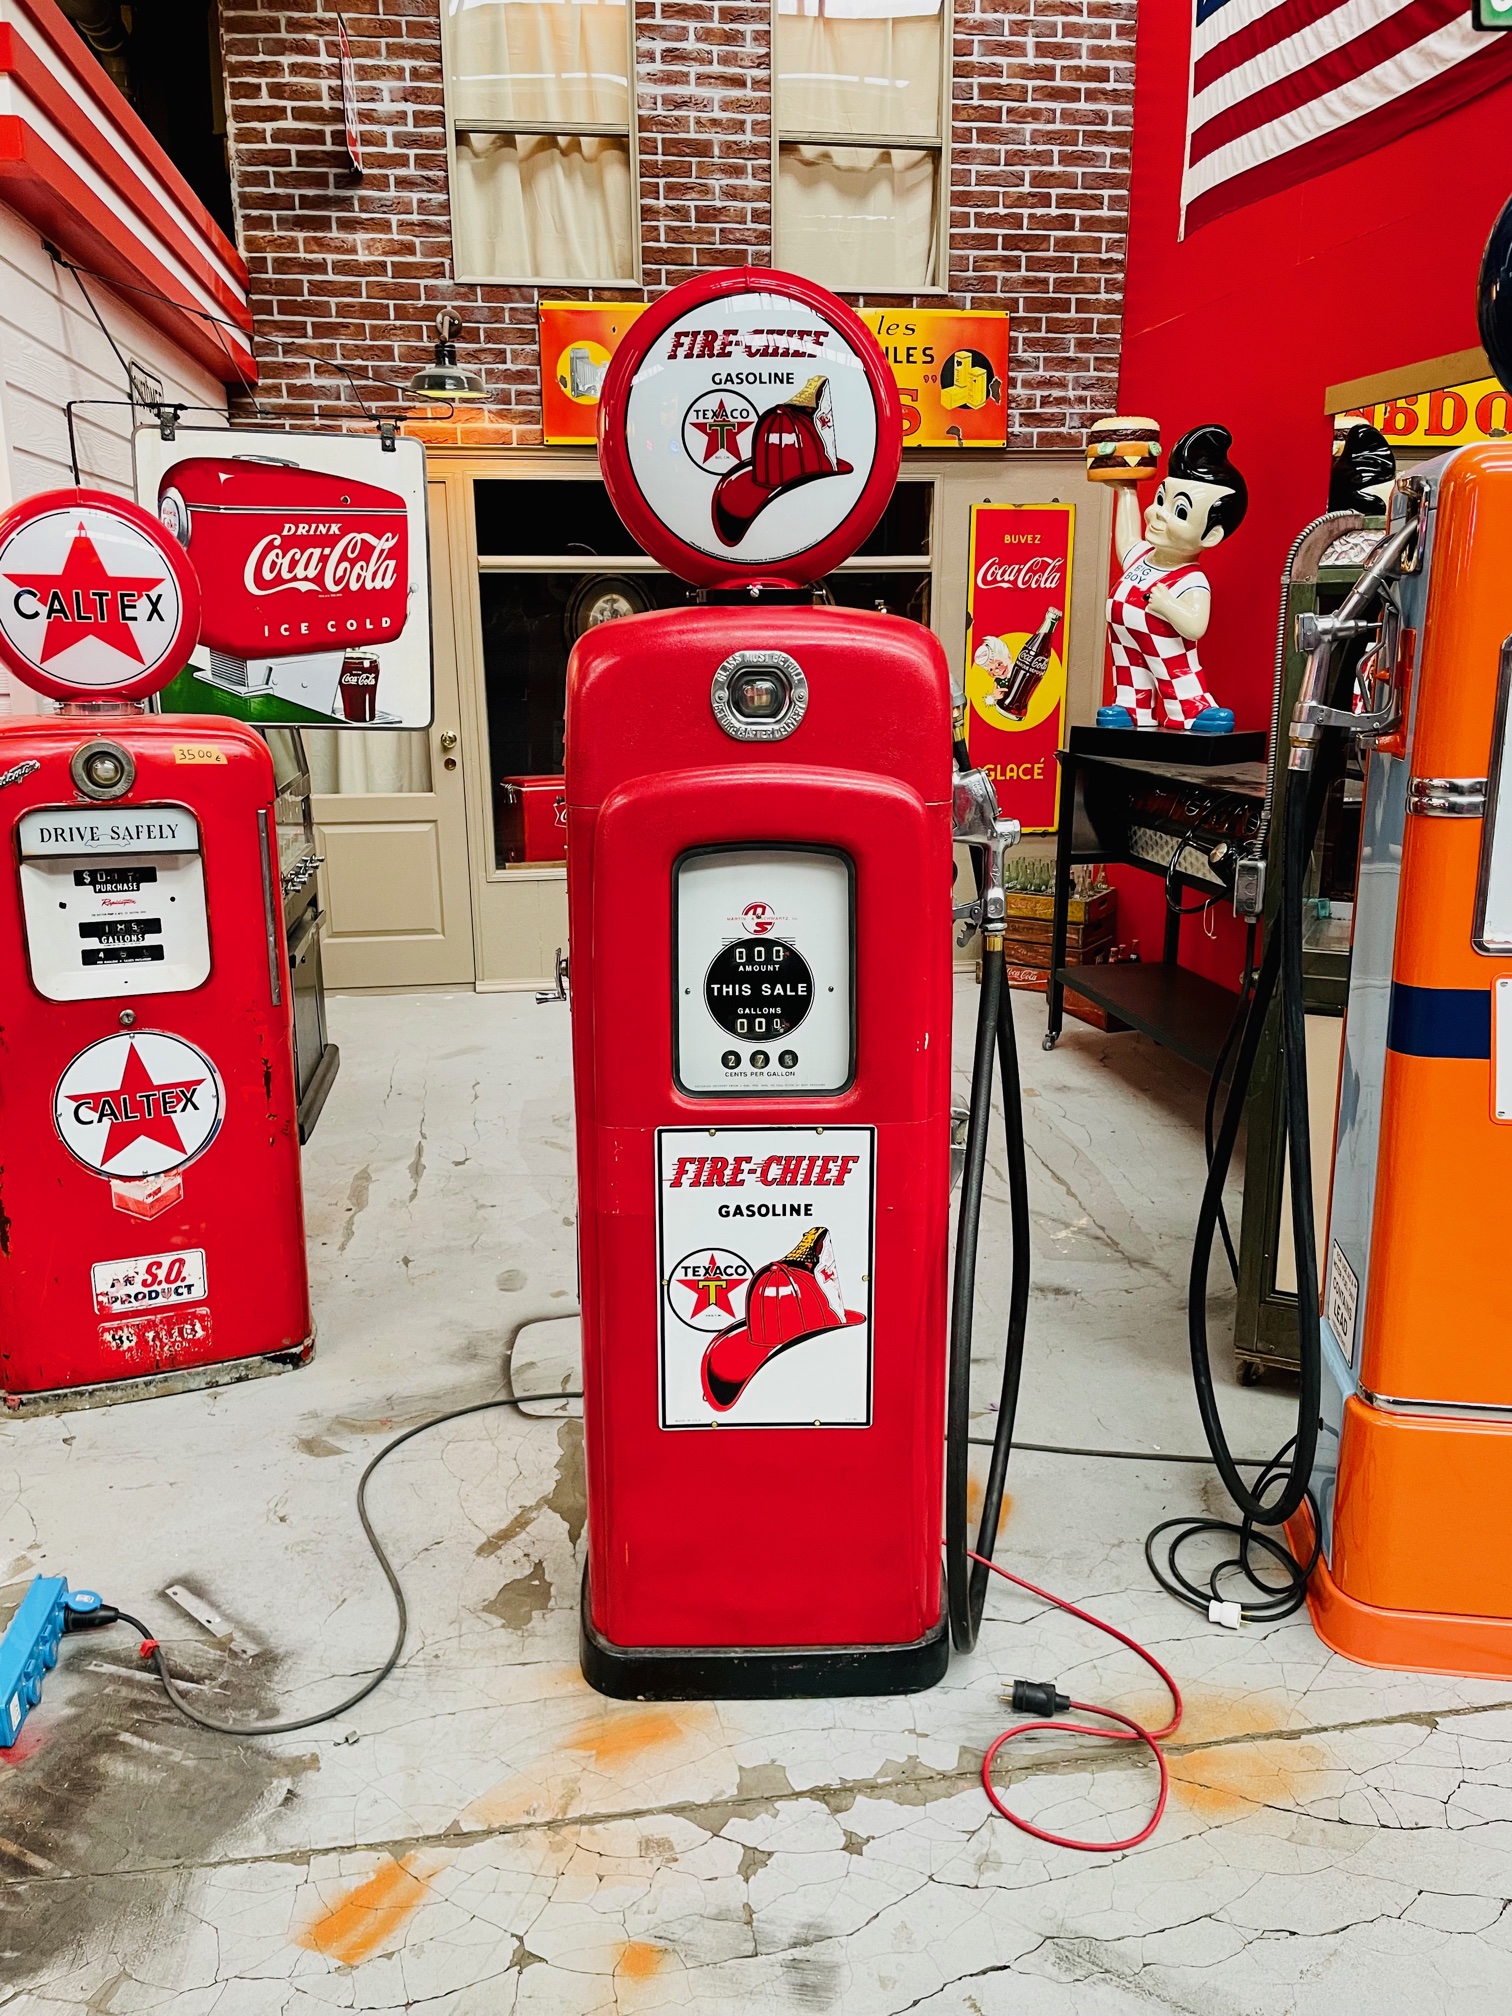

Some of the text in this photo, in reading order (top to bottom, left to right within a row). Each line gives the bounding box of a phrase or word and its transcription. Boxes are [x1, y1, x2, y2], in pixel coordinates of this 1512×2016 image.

[877, 315, 917, 336] les
[711, 372, 795, 386] GASOLINE
[693, 408, 750, 420] TEXACO
[281, 523, 342, 536] DRINK
[1004, 534, 1041, 544] BUVEZ
[243, 532, 399, 596] Coca-Cola
[1134, 564, 1152, 576] BIG
[976, 557, 1065, 589] Coca-Cola
[1124, 571, 1147, 585] BOY
[13, 588, 165, 623] CALTEX
[264, 617, 391, 637] ICE COLD
[983, 757, 1045, 780] GLACÉ
[39, 824, 179, 843] DRIVE SAFELY
[96, 882, 138, 892] PURCHASE
[101, 934, 143, 944] GALLONS
[738, 964, 780, 972] AMOUNT
[710, 983, 808, 996] THIS SALE
[737, 1007, 782, 1015] GALLONS
[73, 1087, 200, 1126] CALTEX
[666, 1155, 860, 1188] FIRE-CHIEF
[717, 1203, 814, 1218] GASOLINE
[141, 1257, 187, 1288] S.O.
[681, 1264, 748, 1279] TEXACO
[107, 1284, 194, 1305] PRODUCT
[698, 1280, 727, 1307] T
[1333, 1298, 1348, 1337] LEAD
